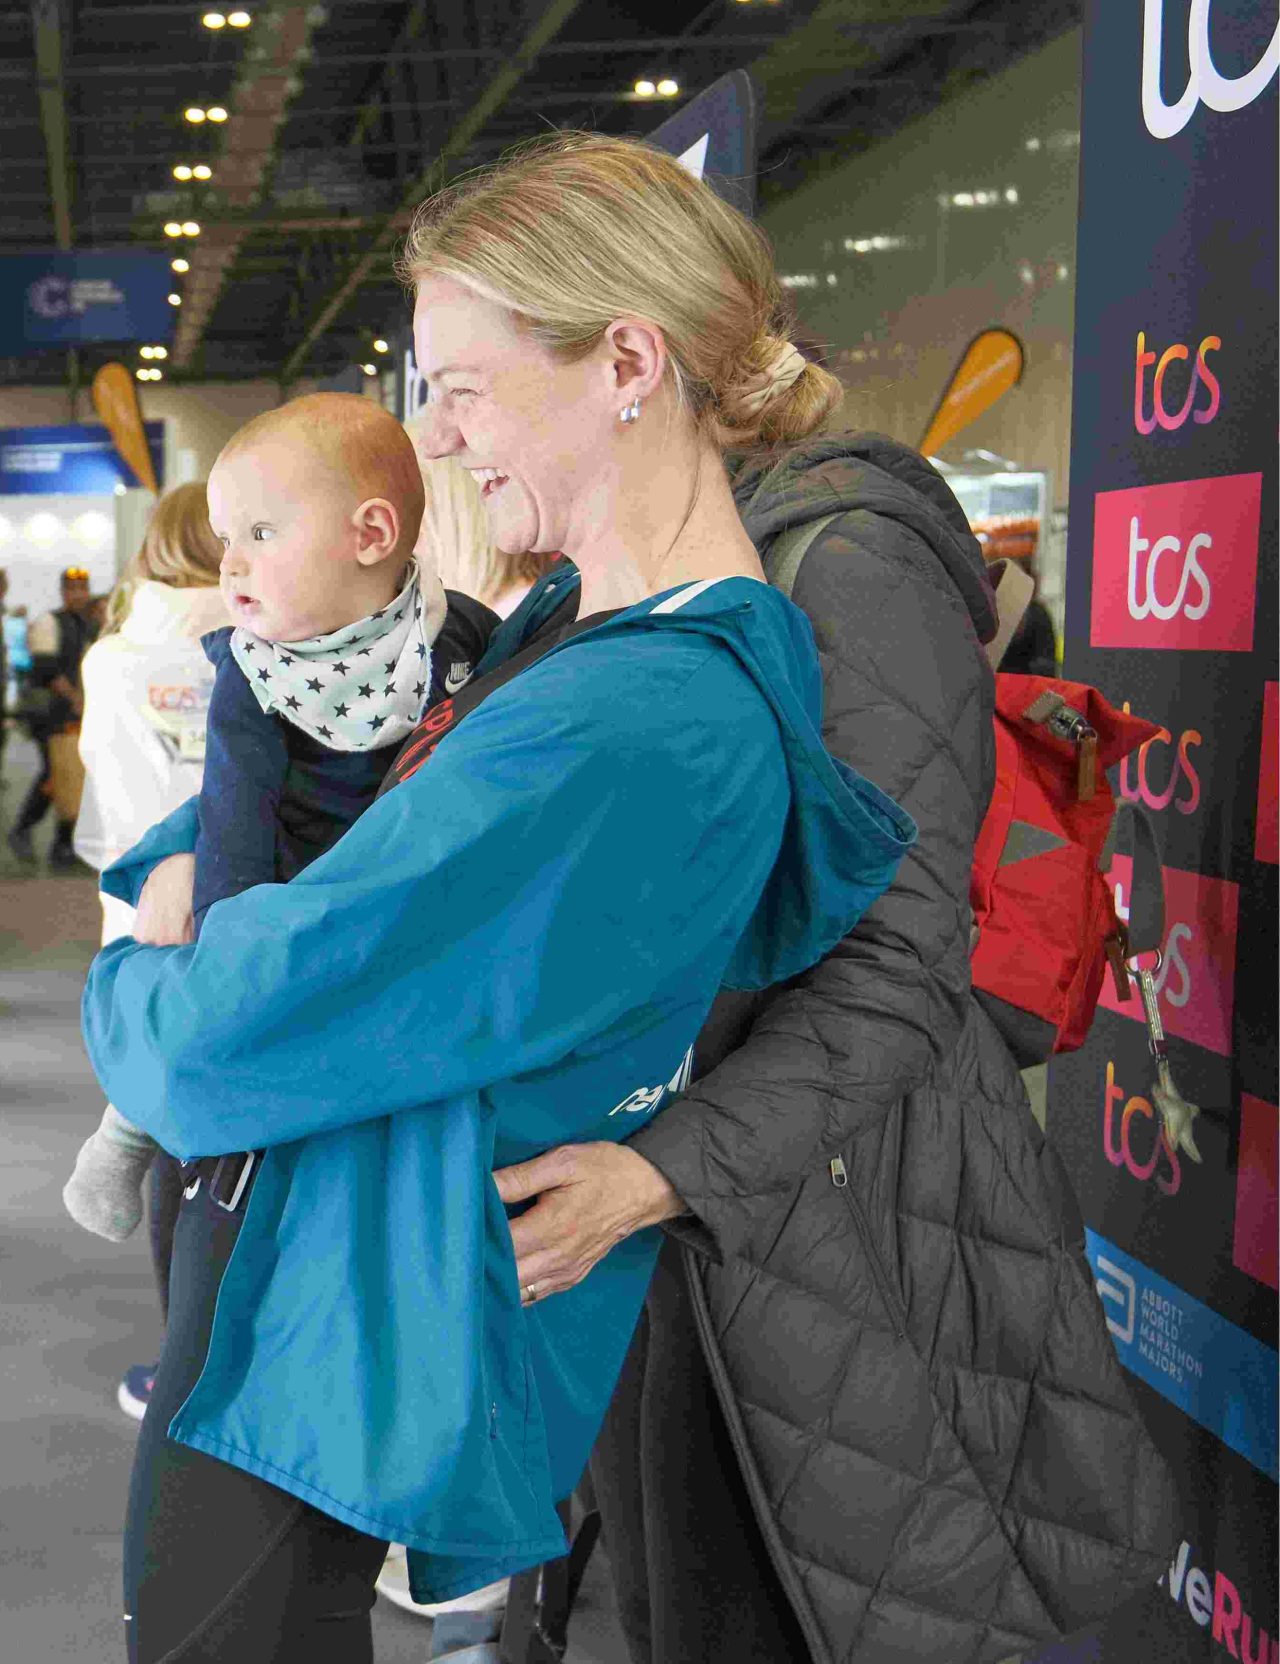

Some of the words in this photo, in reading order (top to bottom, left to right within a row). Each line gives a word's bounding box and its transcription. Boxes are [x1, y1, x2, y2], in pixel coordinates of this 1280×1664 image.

[1134, 331, 1222, 436] tcs
[1127, 516, 1213, 621] tcs
[450, 661, 471, 680] NIKE
[1120, 701, 1202, 815] tcs
[1141, 1287, 1184, 1327] ABBOTT
[1141, 1302, 1179, 1341] WORLD
[1139, 1341, 1183, 1383] MAJORS
[1140, 1322, 1203, 1378] MARATHON
